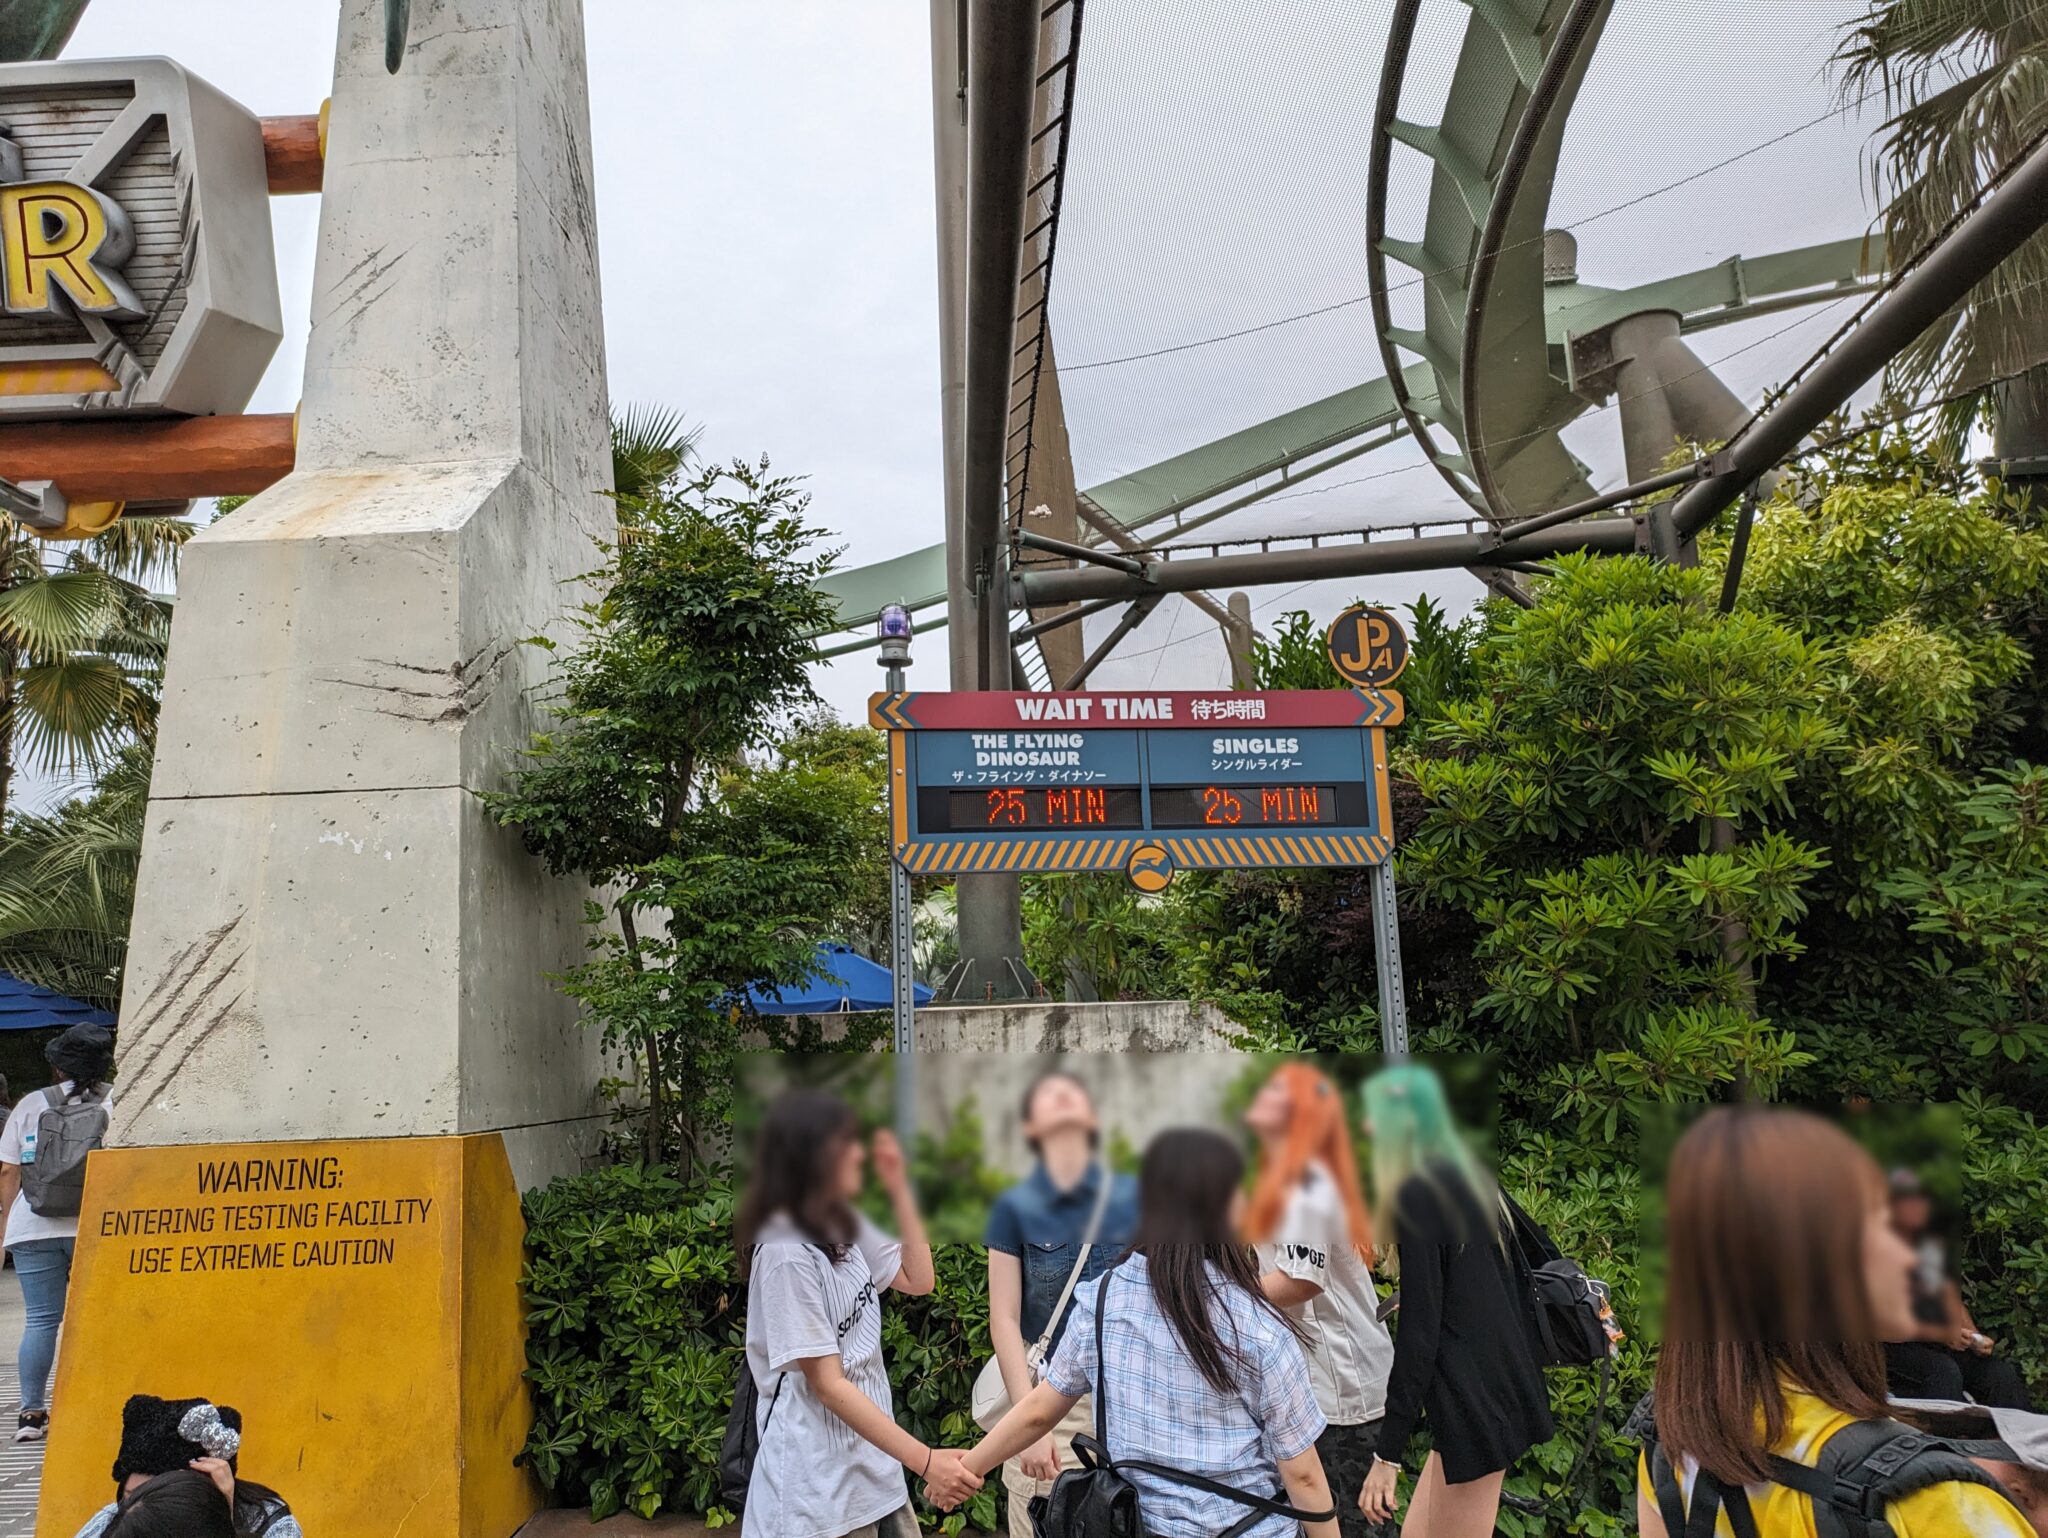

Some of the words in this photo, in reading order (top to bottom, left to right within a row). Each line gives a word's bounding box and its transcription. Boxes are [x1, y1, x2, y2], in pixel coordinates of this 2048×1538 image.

[1015, 698, 1092, 720] WAIT
[1101, 698, 1174, 720] TIME
[1190, 699, 1266, 720] 待ち時間
[971, 734, 1008, 749] THE
[1014, 733, 1084, 749] FLYING
[1212, 738, 1299, 754] SINGLES
[976, 751, 1080, 766] DINOSAUR
[1211, 758, 1303, 771] シングルライダー
[951, 769, 1107, 783] ザ・フライング・ダイナソー
[1047, 788, 1105, 824] MIN
[1262, 786, 1319, 822] MIN
[197, 1156, 344, 1194] WARNING:
[100, 1206, 215, 1237] ENTERING
[221, 1202, 319, 1231] TESTING
[324, 1198, 433, 1227] FACILITY
[128, 1247, 173, 1274] USE
[179, 1243, 285, 1272] EXTREME
[292, 1239, 394, 1268] CAUTION
